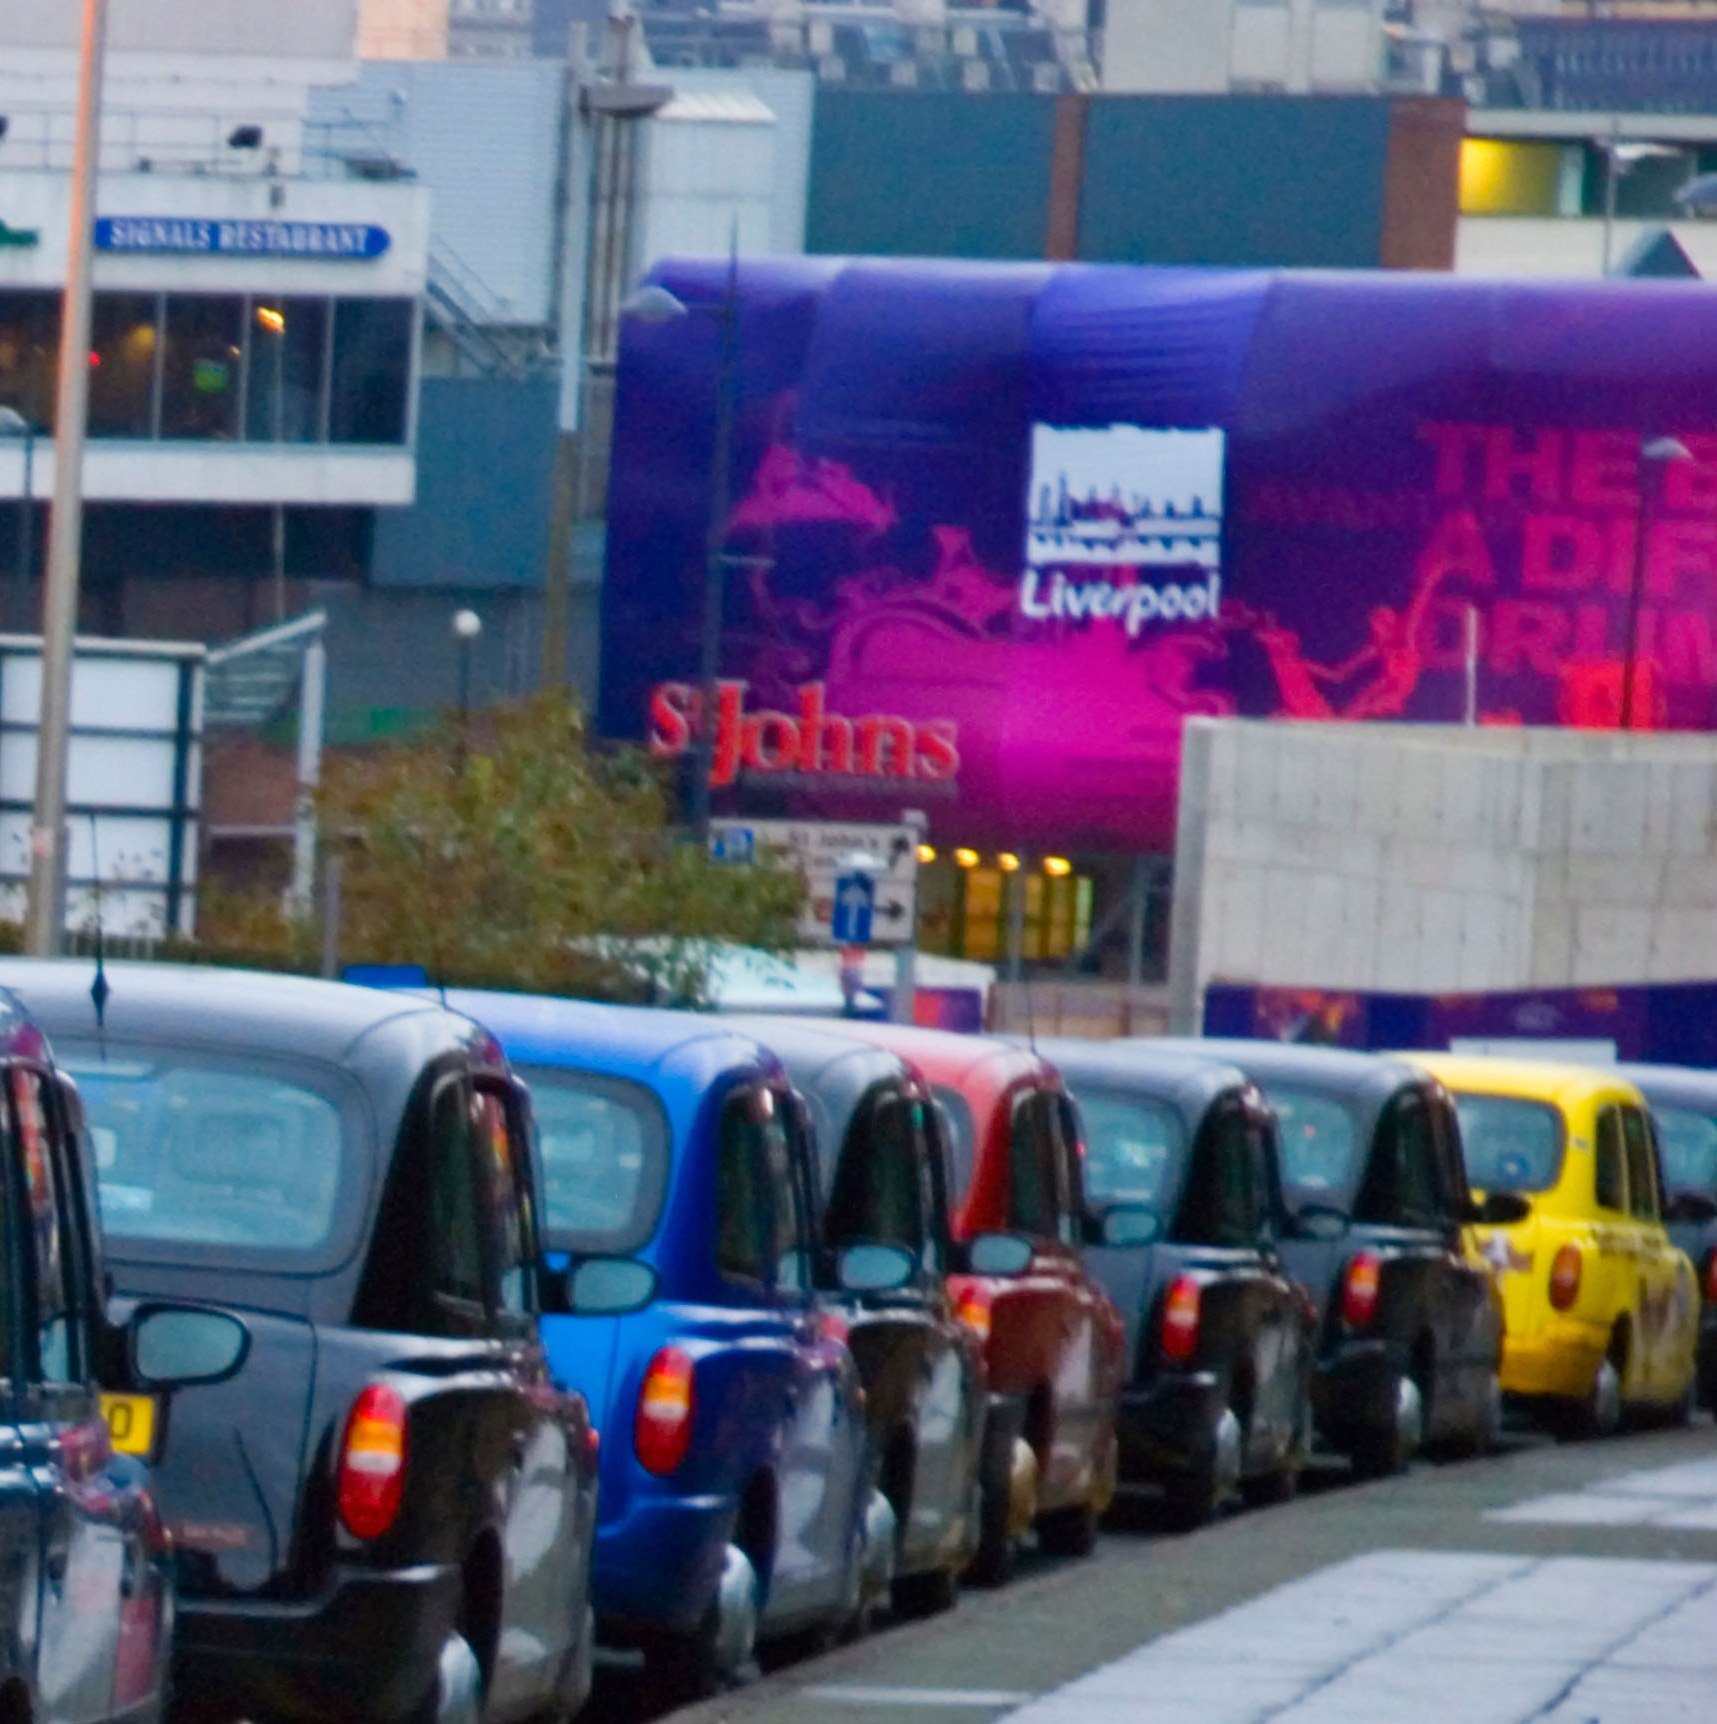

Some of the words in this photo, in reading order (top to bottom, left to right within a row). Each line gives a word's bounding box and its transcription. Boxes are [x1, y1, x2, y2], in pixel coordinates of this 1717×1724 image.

[110, 219, 211, 249] SIGNALS
[218, 221, 368, 253] RESTAURANT
[1020, 568, 1222, 638] Liverpool
[707, 677, 961, 790] Johns
